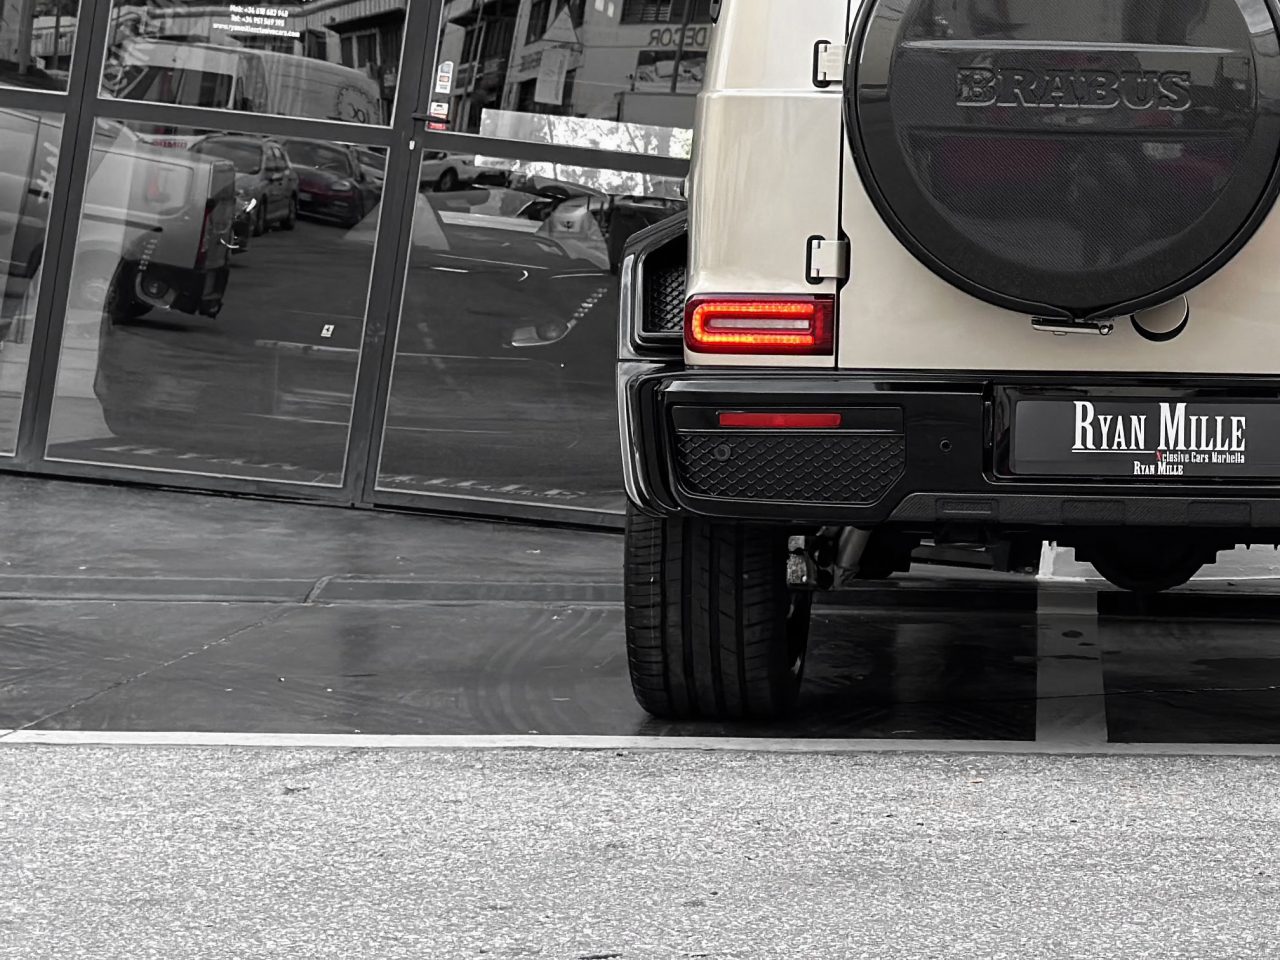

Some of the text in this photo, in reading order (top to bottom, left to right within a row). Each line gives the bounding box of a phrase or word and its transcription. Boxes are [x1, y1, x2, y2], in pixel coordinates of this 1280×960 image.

[956, 67, 1191, 111] BRABUS
[1072, 401, 1246, 451] RYAN MILLE
[1133, 461, 1184, 476] RYAN MILLE
[1191, 452, 1208, 463] Cars
[1212, 452, 1245, 464] Marbella
